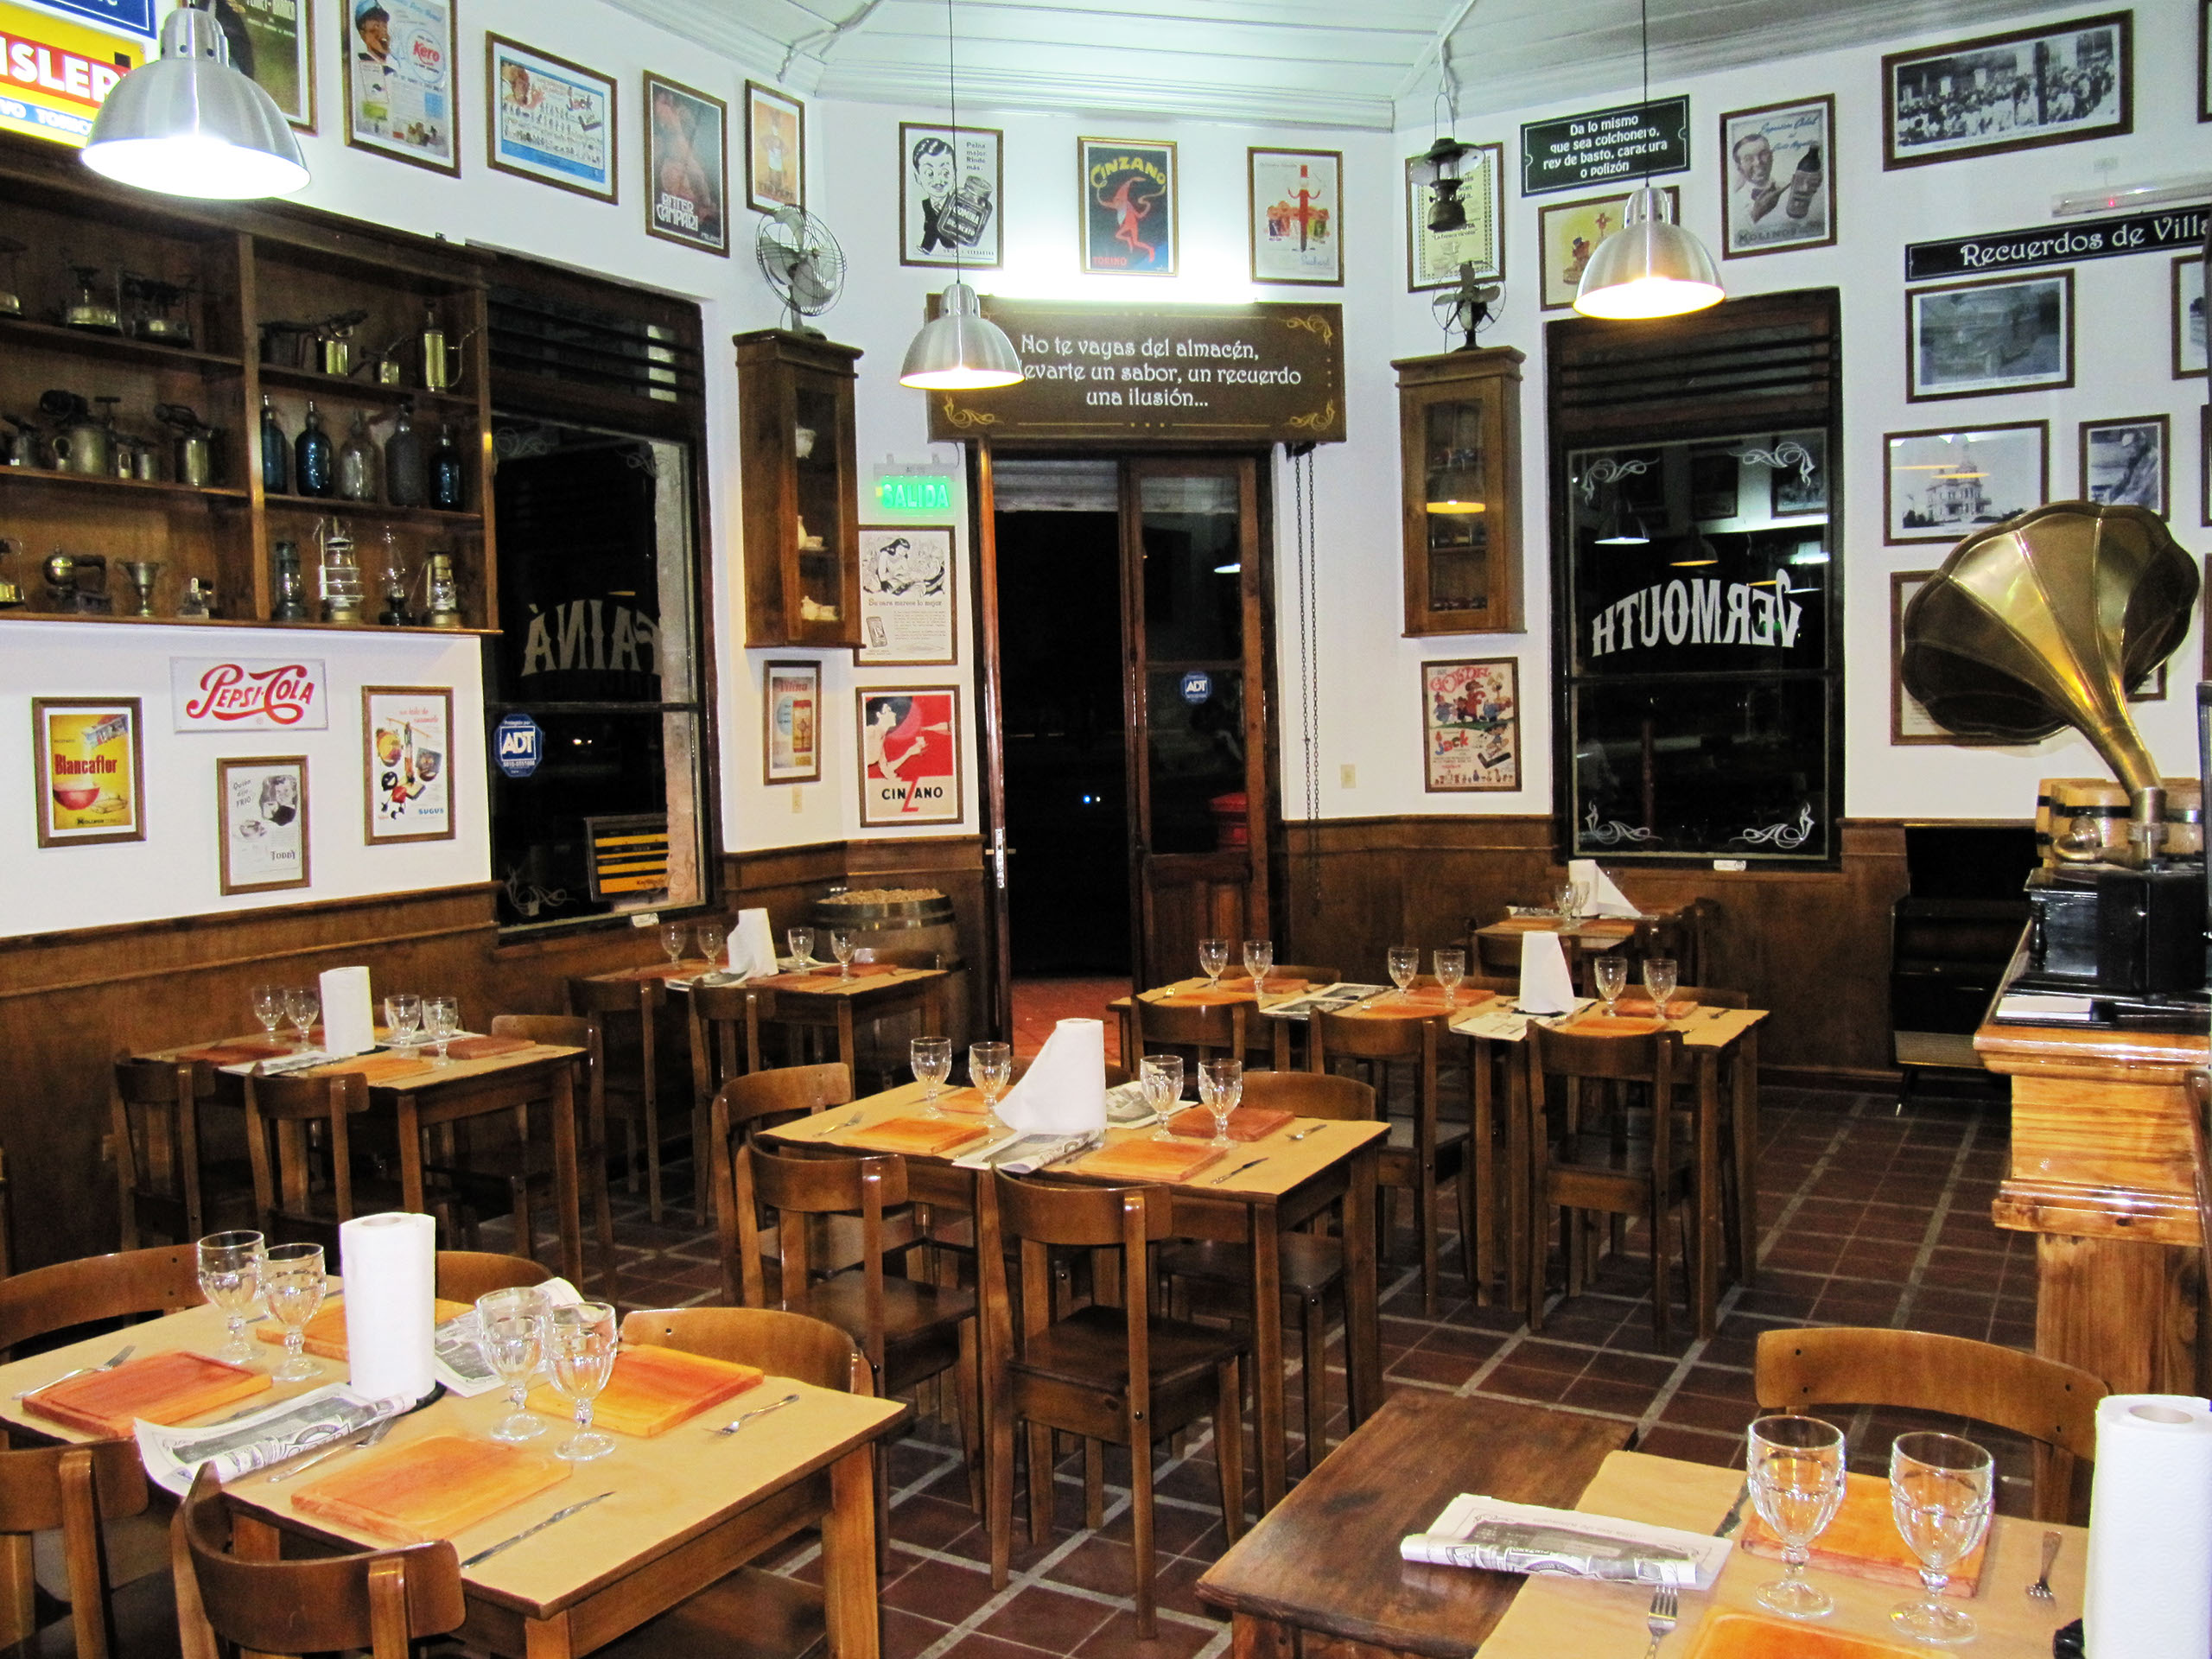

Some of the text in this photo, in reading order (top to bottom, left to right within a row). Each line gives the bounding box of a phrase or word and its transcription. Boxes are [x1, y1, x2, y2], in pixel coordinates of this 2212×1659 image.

[1570, 115, 1638, 137] Da lo mismo
[1550, 142, 1570, 154] que
[1573, 138, 1592, 150] sea
[1090, 156, 1166, 188] CINZANO
[1543, 157, 1561, 170] rey
[1564, 154, 1577, 166] de
[1580, 161, 1630, 178] o polizón
[657, 204, 699, 232] CAMPARI
[1960, 231, 2104, 268] Recuerdos
[2112, 224, 2145, 247] de
[1021, 334, 1259, 360] No te vayas del almacén,
[1091, 365, 1115, 380] un
[1122, 363, 1182, 384] sabor,
[1188, 368, 1211, 383] un
[1217, 366, 1301, 385] recuerdo
[1086, 388, 1209, 407] una ilusión...
[882, 483, 949, 508] SALIDA
[1185, 680, 1206, 692] ADT
[501, 731, 536, 754] ADT
[54, 753, 118, 775] Blancaflor
[881, 777, 944, 812] CINZANO
